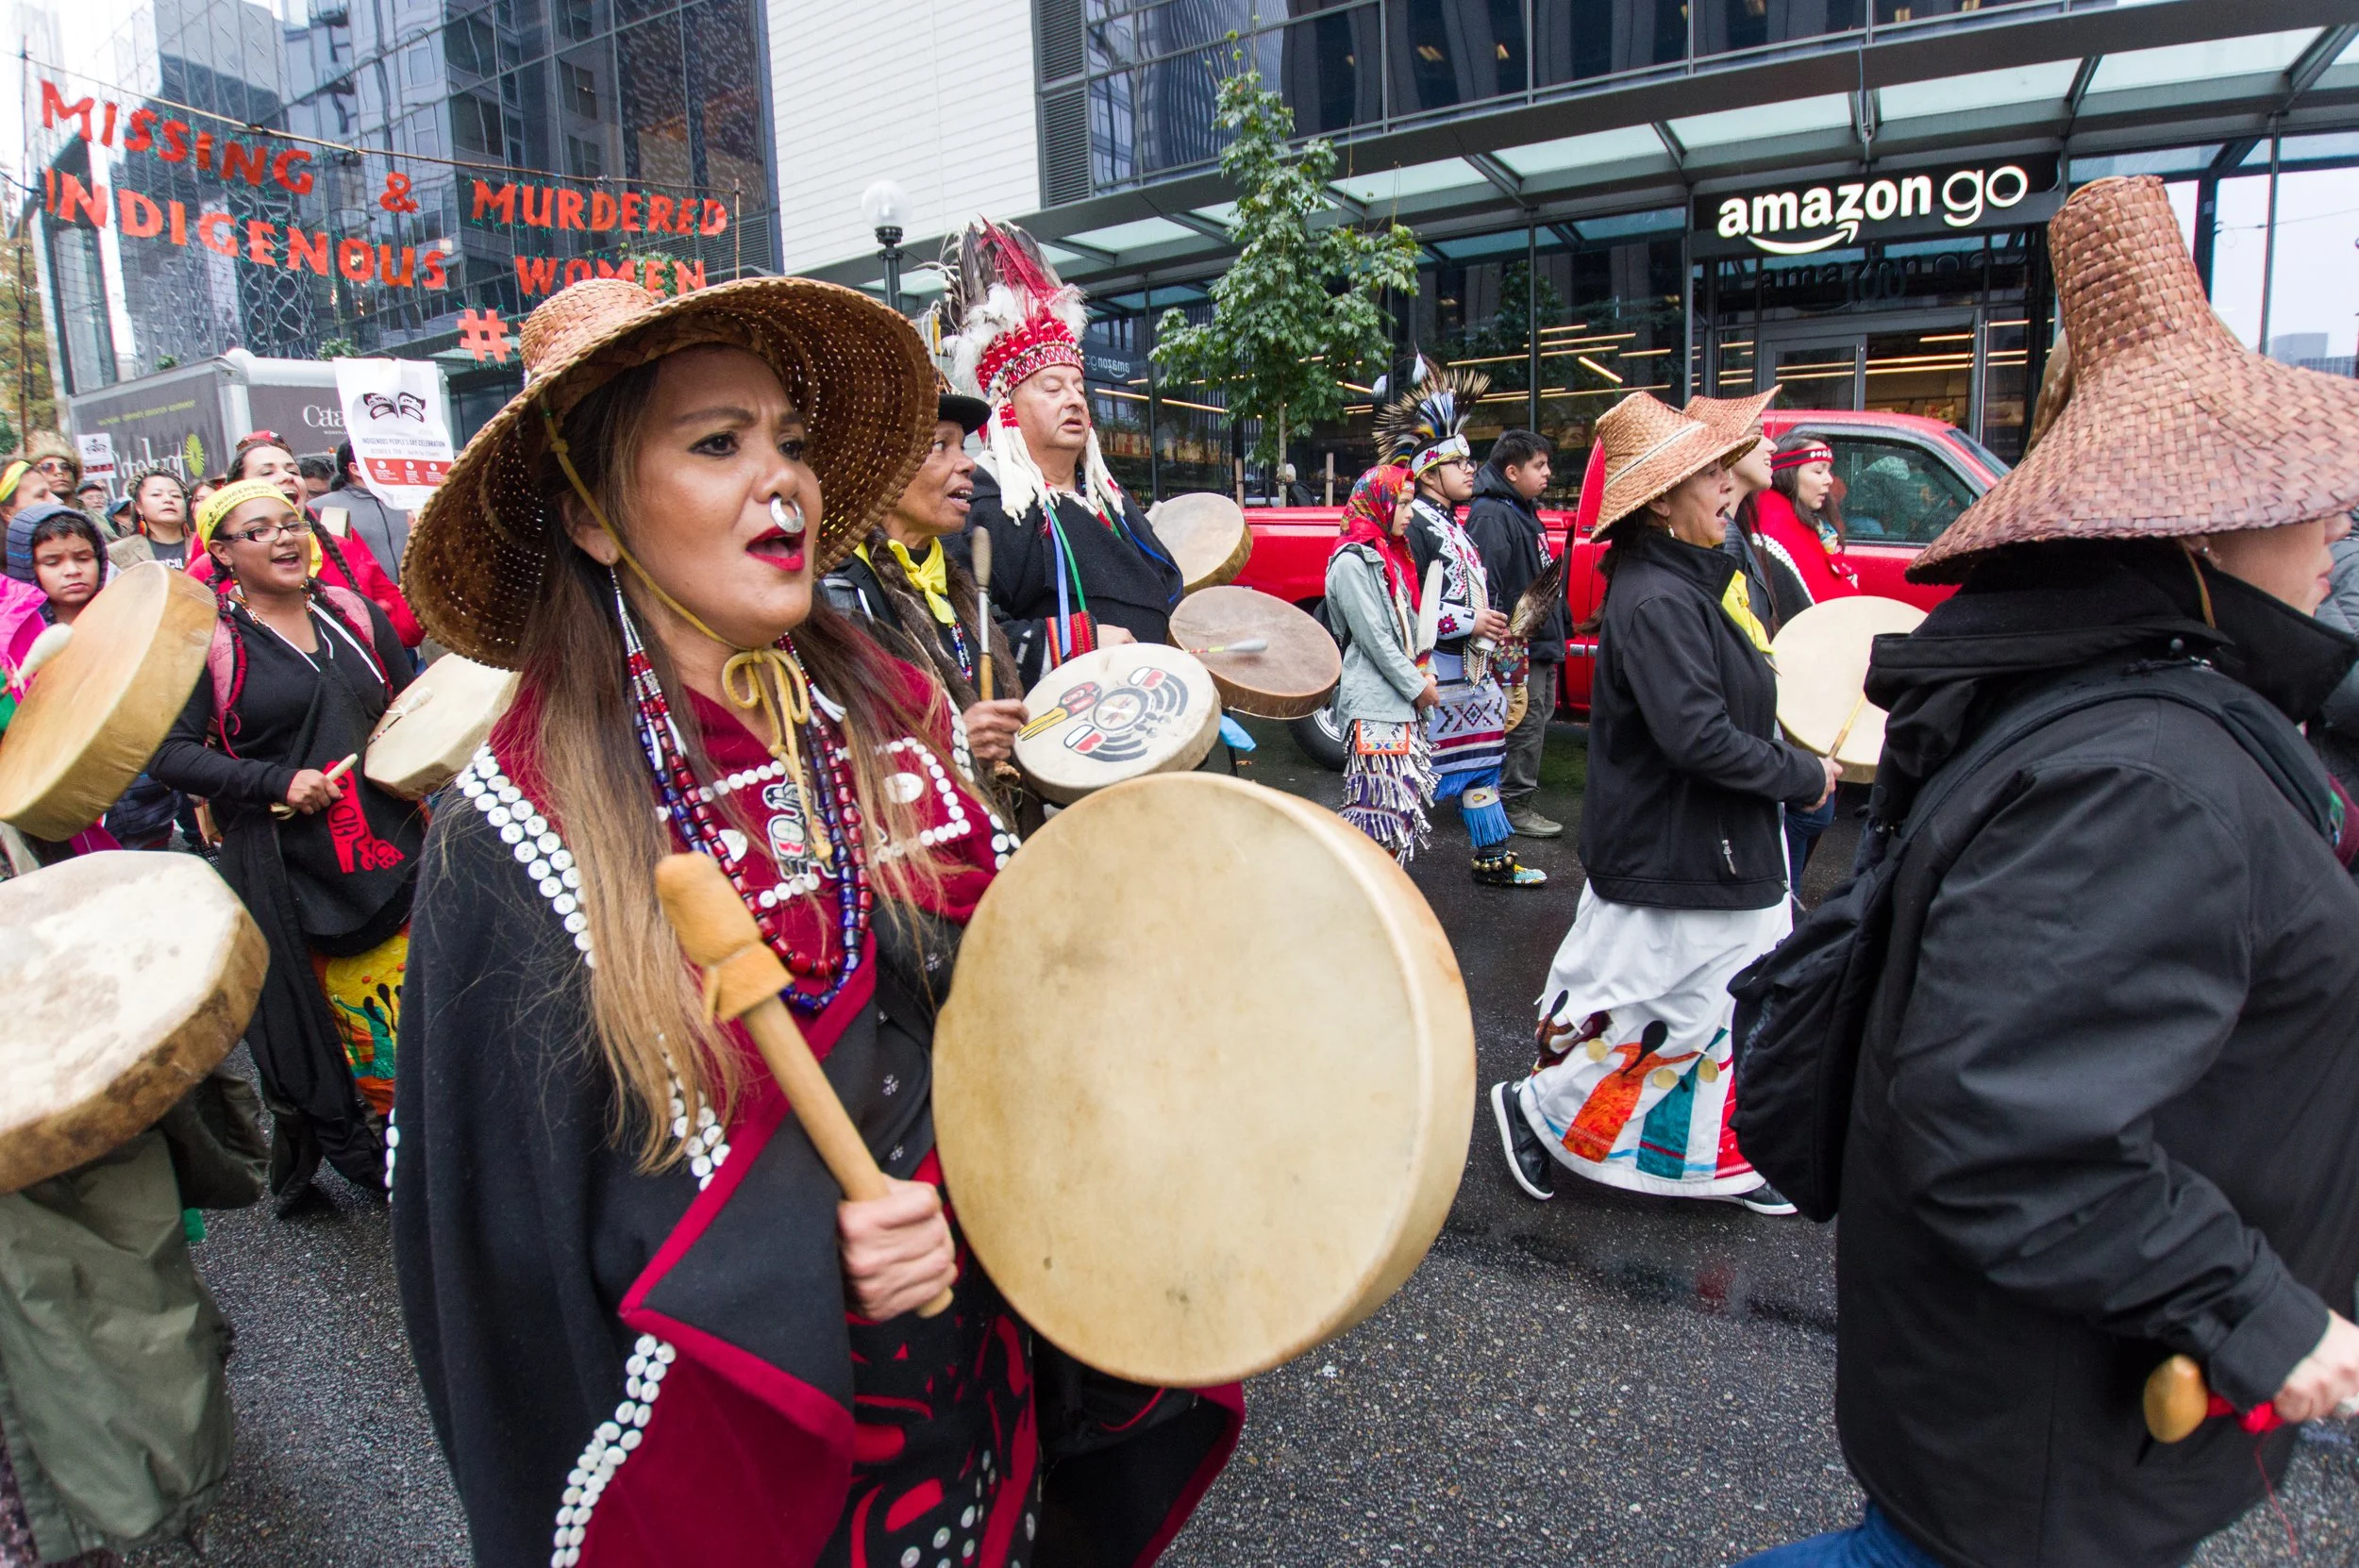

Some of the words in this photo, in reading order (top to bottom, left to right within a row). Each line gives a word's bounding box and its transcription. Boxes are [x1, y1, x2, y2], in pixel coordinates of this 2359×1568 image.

[41, 78, 313, 195] MISSING
[379, 172, 418, 213] &
[473, 179, 728, 236] MURDERED
[46, 167, 447, 290] INDIGENOUS
[515, 256, 708, 299] WOMEN
[1717, 175, 1932, 239] amazon
[1941, 165, 2029, 227] go
[302, 404, 344, 427] Cata
[418, 439, 446, 447] CELEBRATION
